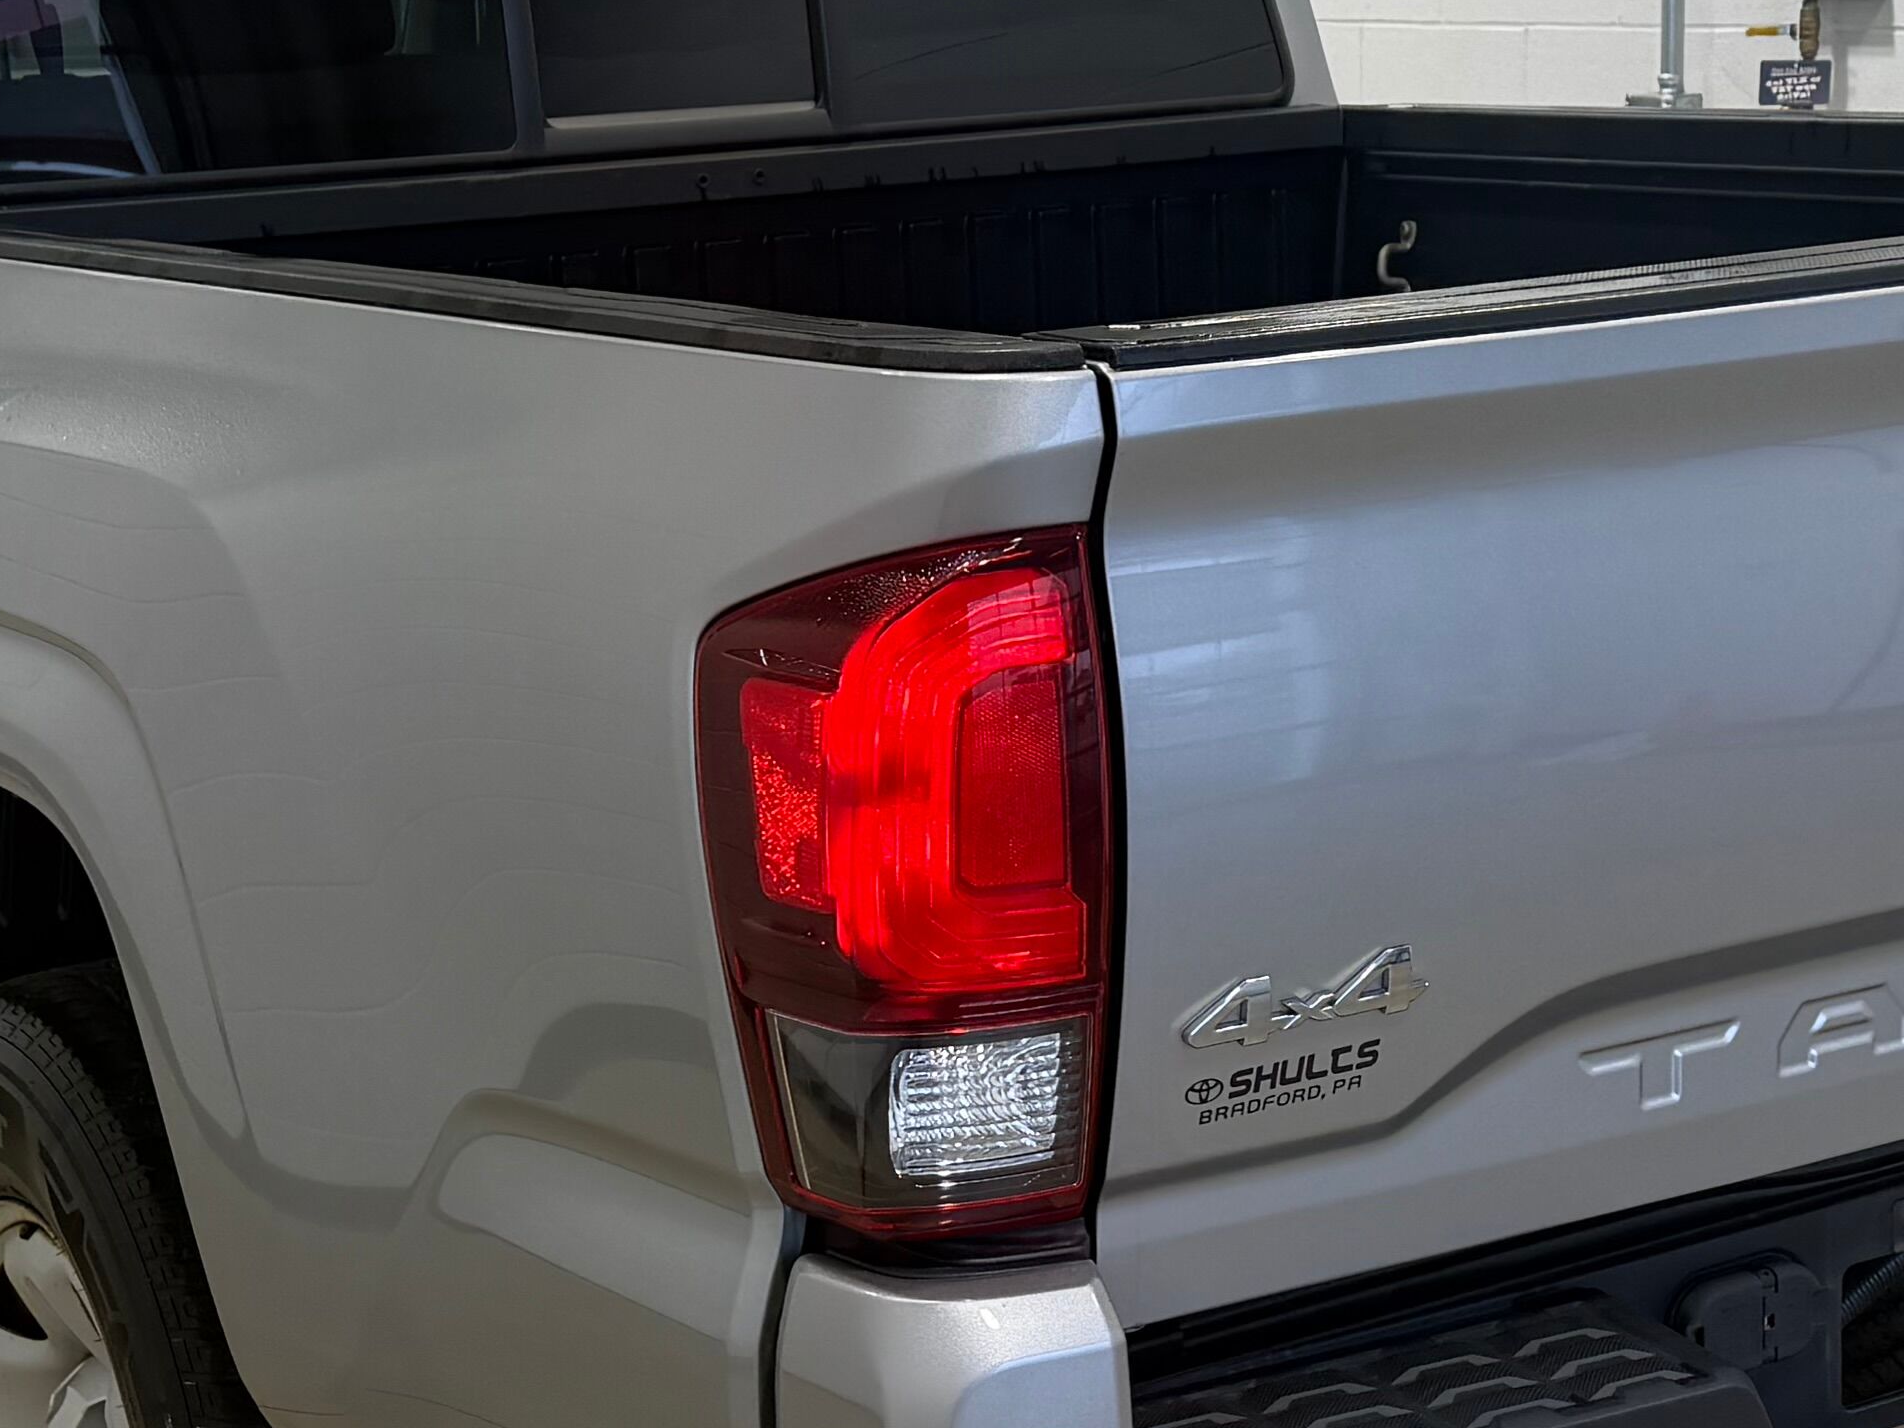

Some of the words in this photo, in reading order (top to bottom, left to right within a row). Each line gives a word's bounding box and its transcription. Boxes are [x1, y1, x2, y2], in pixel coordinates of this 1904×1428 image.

[1228, 1038, 1381, 1099] SHULTS
[1198, 1084, 1326, 1125] BRADFORD,
[1332, 1074, 1363, 1095] PA
